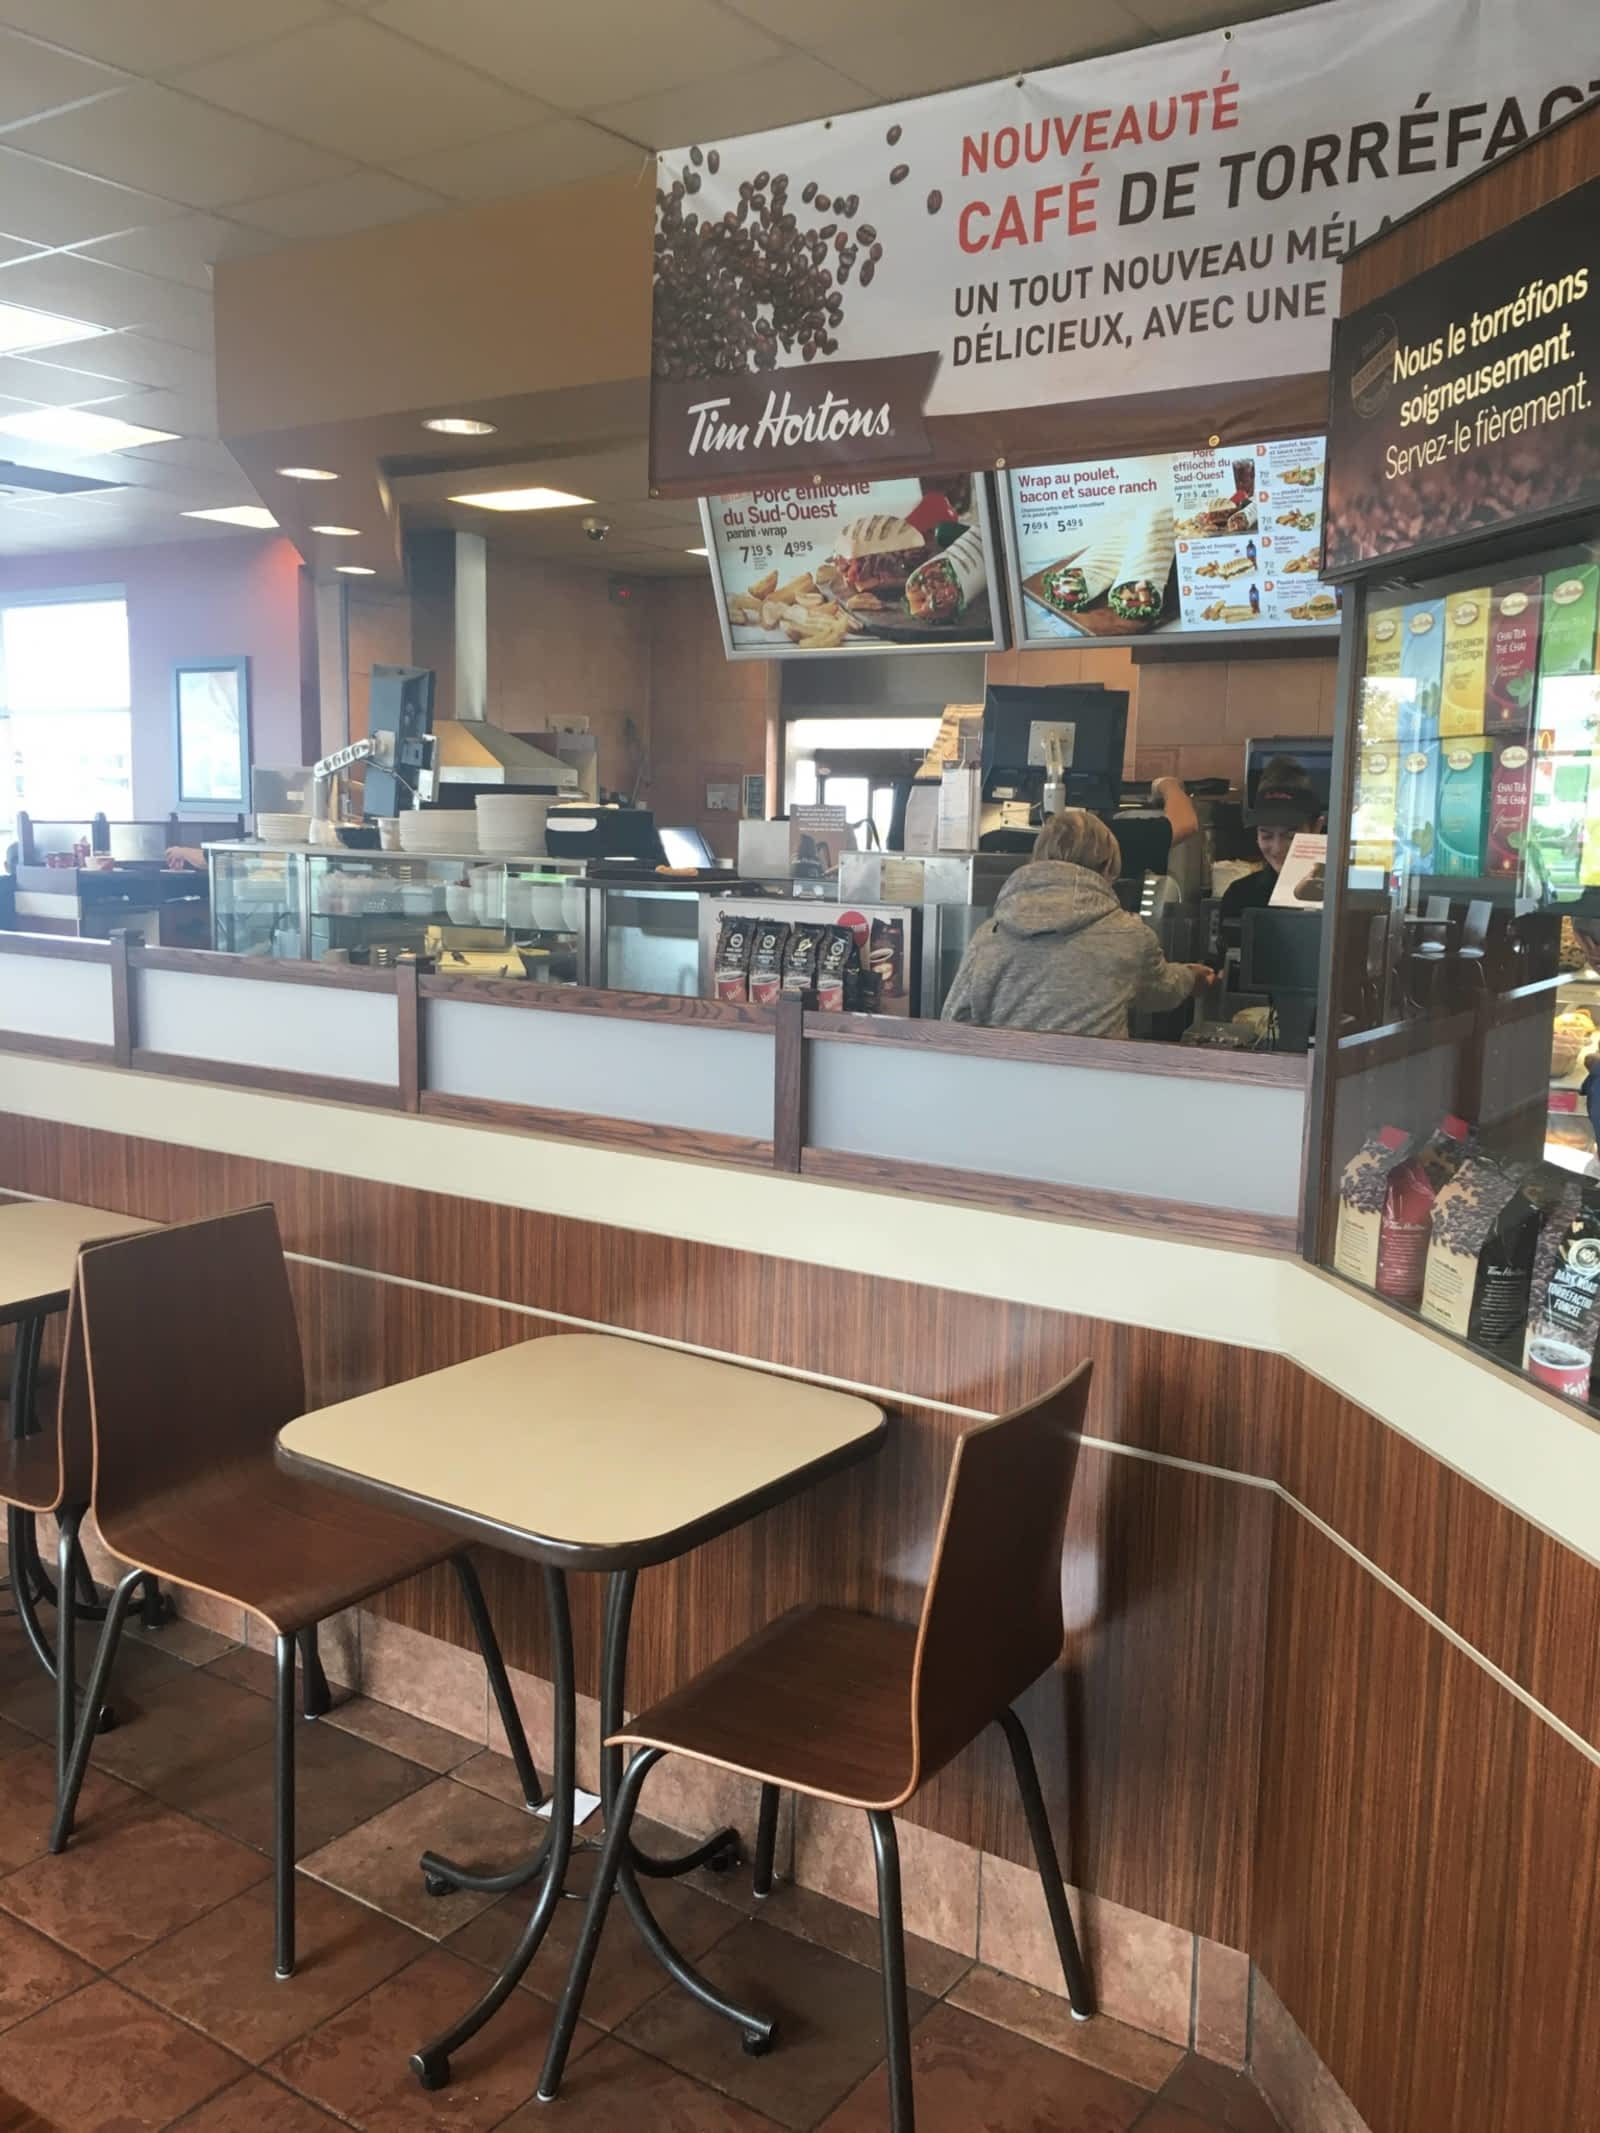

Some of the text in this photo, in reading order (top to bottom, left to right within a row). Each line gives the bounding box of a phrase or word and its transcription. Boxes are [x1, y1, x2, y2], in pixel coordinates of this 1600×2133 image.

[961, 70, 1240, 176] NOUVEAUTÉ
[959, 80, 1600, 254] CAFÉ DE TORRÉFAC
[954, 282, 998, 317] UN
[1008, 266, 1093, 307] TOUT
[1104, 234, 1274, 294] NOUVEAU
[953, 280, 1327, 367] DÉLICIEUX, AVEC UNE
[1392, 337, 1443, 384] Nous
[1447, 323, 1467, 359] le
[1470, 267, 1589, 348] torréfions
[1400, 322, 1576, 427] soigneusement.
[687, 391, 891, 457] Tim Hortons
[1218, 458, 1231, 467] du
[1385, 371, 1593, 480] Servez-le fièrement.
[723, 500, 838, 526] du Sud-Ouest
[1018, 474, 1052, 488] Wrap
[1054, 474, 1070, 484] au
[1020, 478, 1157, 504] bacon et sauce ranch
[726, 526, 788, 541] panini wrap
